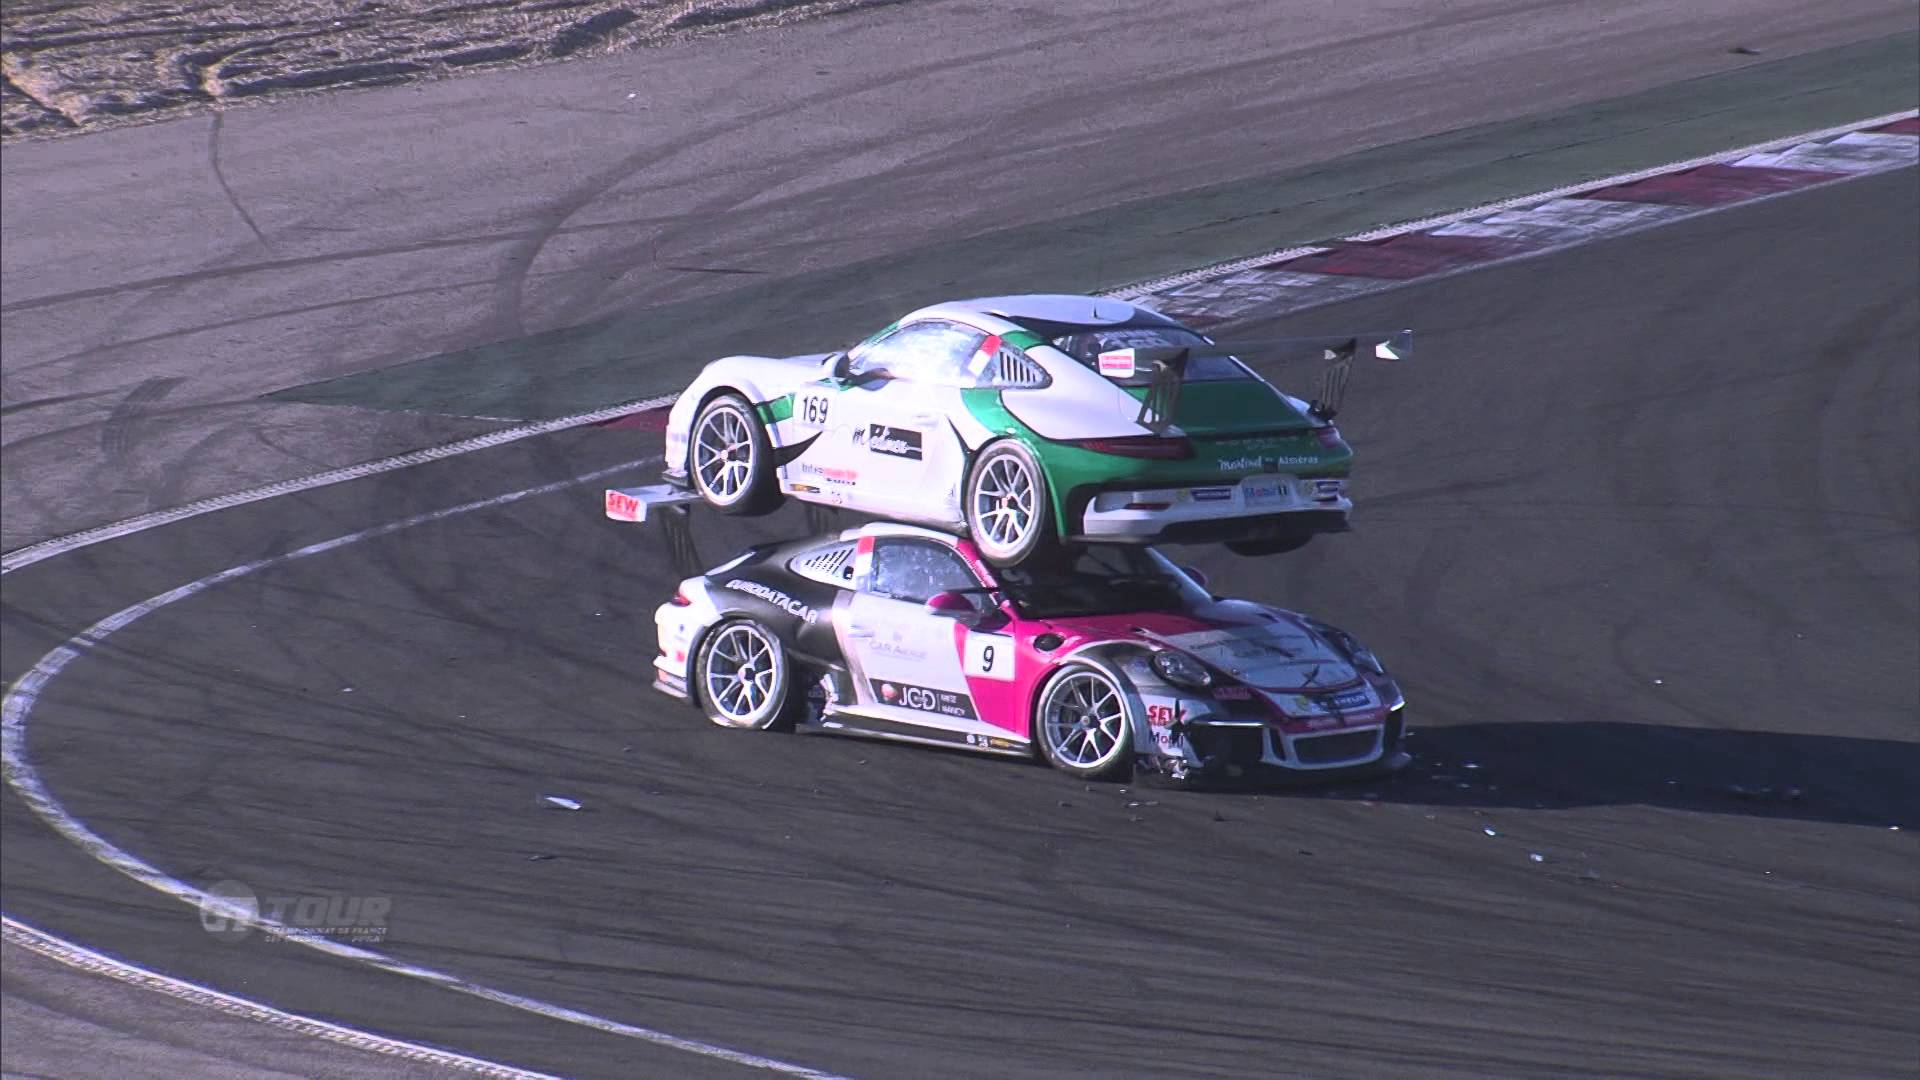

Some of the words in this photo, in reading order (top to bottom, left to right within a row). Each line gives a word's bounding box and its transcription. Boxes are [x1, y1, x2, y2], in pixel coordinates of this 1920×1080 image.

[803, 396, 828, 424] 169
[608, 493, 639, 514] SEW
[982, 645, 995, 673] 9
